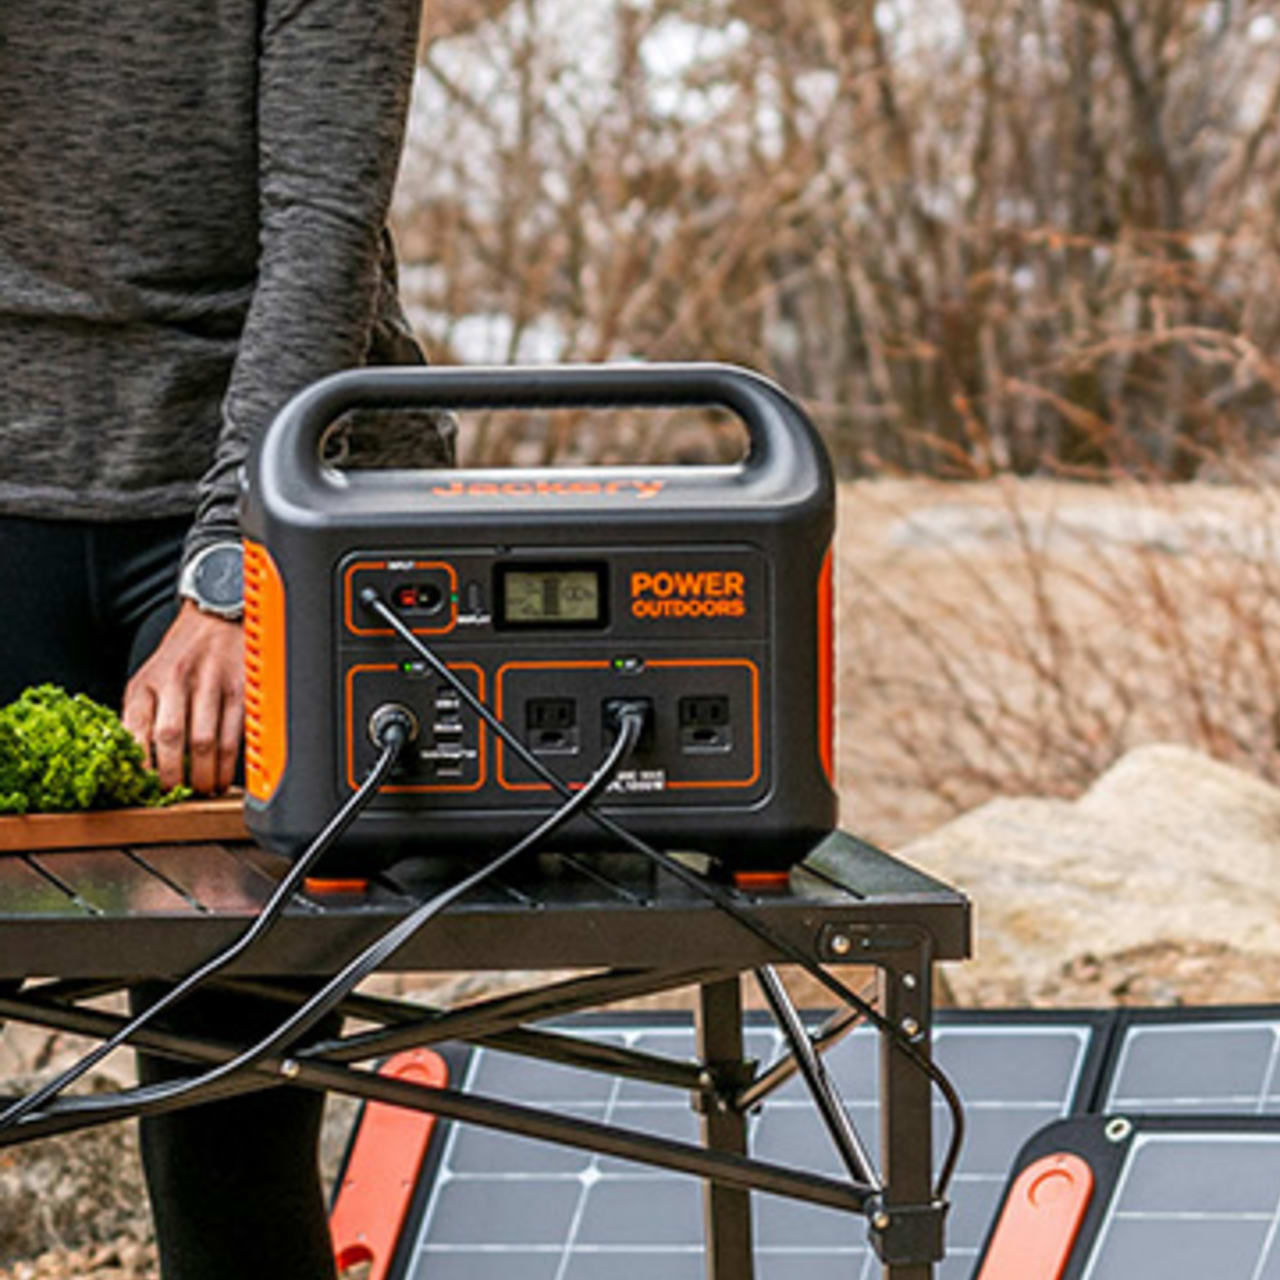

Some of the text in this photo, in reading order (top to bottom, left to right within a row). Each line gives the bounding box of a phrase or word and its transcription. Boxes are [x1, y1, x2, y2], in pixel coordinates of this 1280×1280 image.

[433, 479, 666, 499] Jackery
[630, 571, 746, 598] POWER
[631, 600, 746, 619] OUTDOORS
